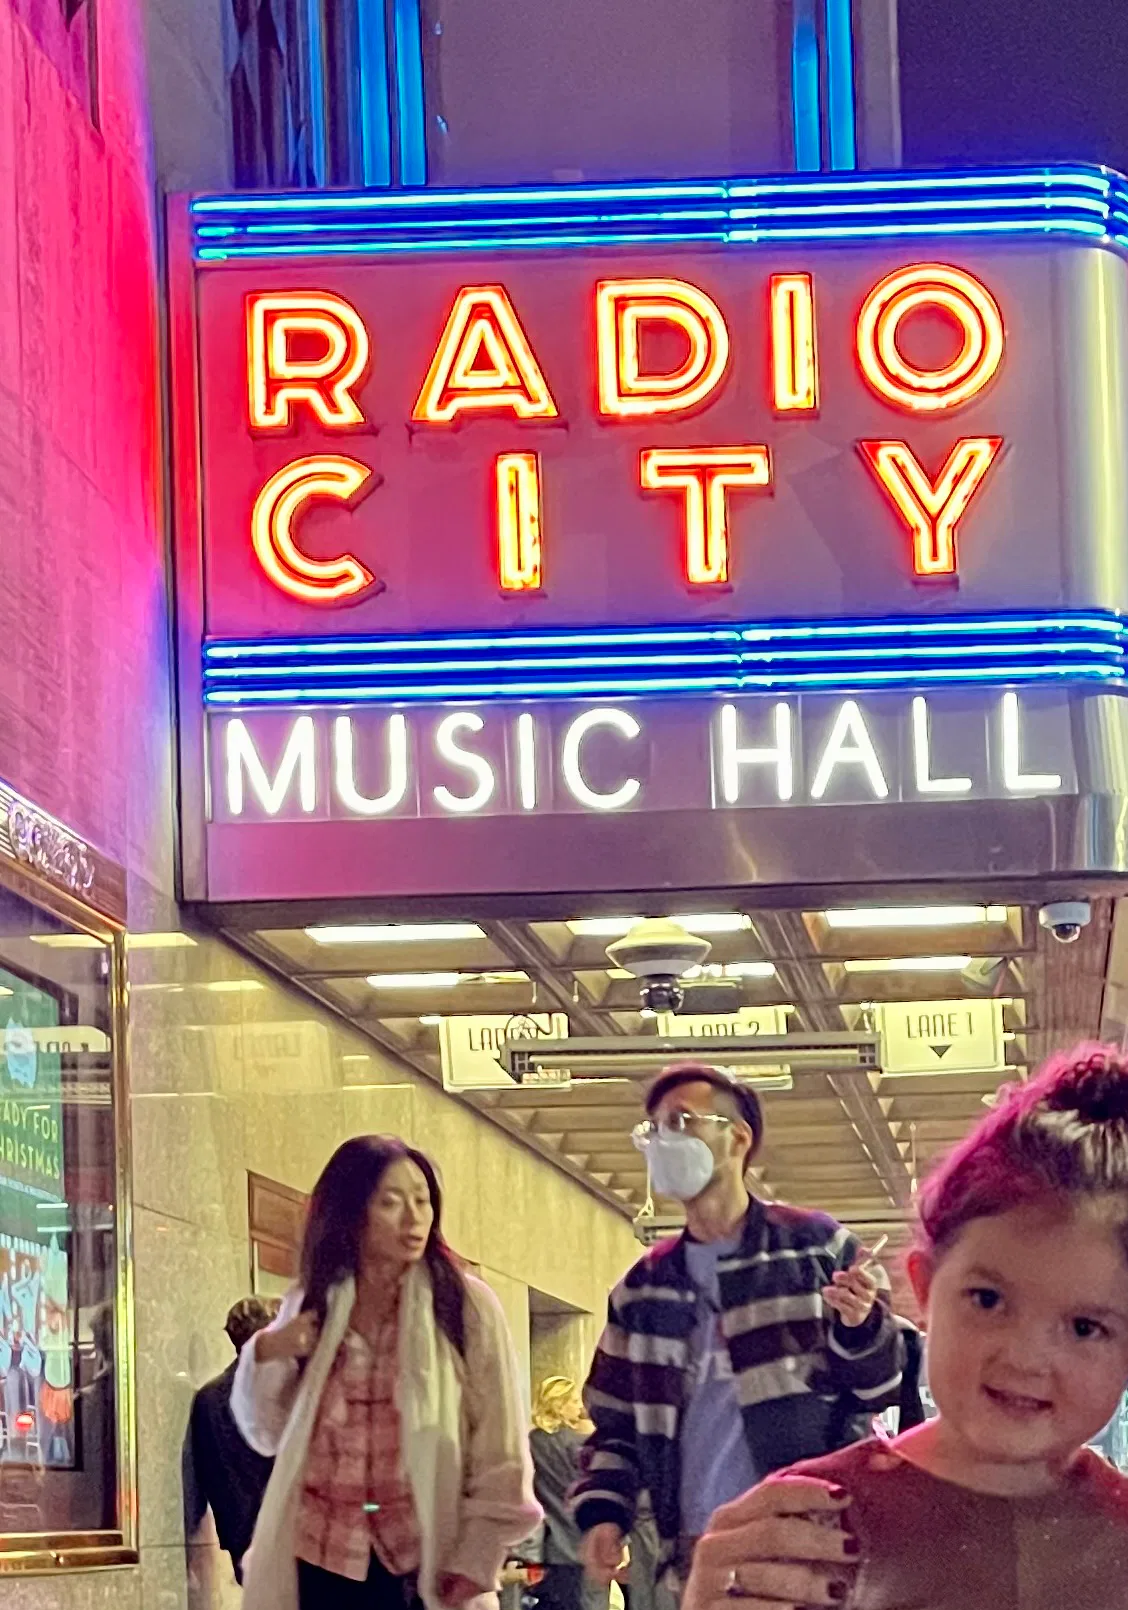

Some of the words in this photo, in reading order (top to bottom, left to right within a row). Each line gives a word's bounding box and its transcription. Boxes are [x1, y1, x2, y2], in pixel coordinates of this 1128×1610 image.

[245, 262, 1005, 428] RADIO
[251, 436, 1004, 602] CITY
[225, 707, 642, 815] MUSIC
[720, 694, 1063, 804] HALL
[907, 1013, 959, 1038] LANE
[966, 1012, 973, 1035] 1
[0, 1100, 28, 1130] ADY
[33, 1111, 58, 1143] FOR
